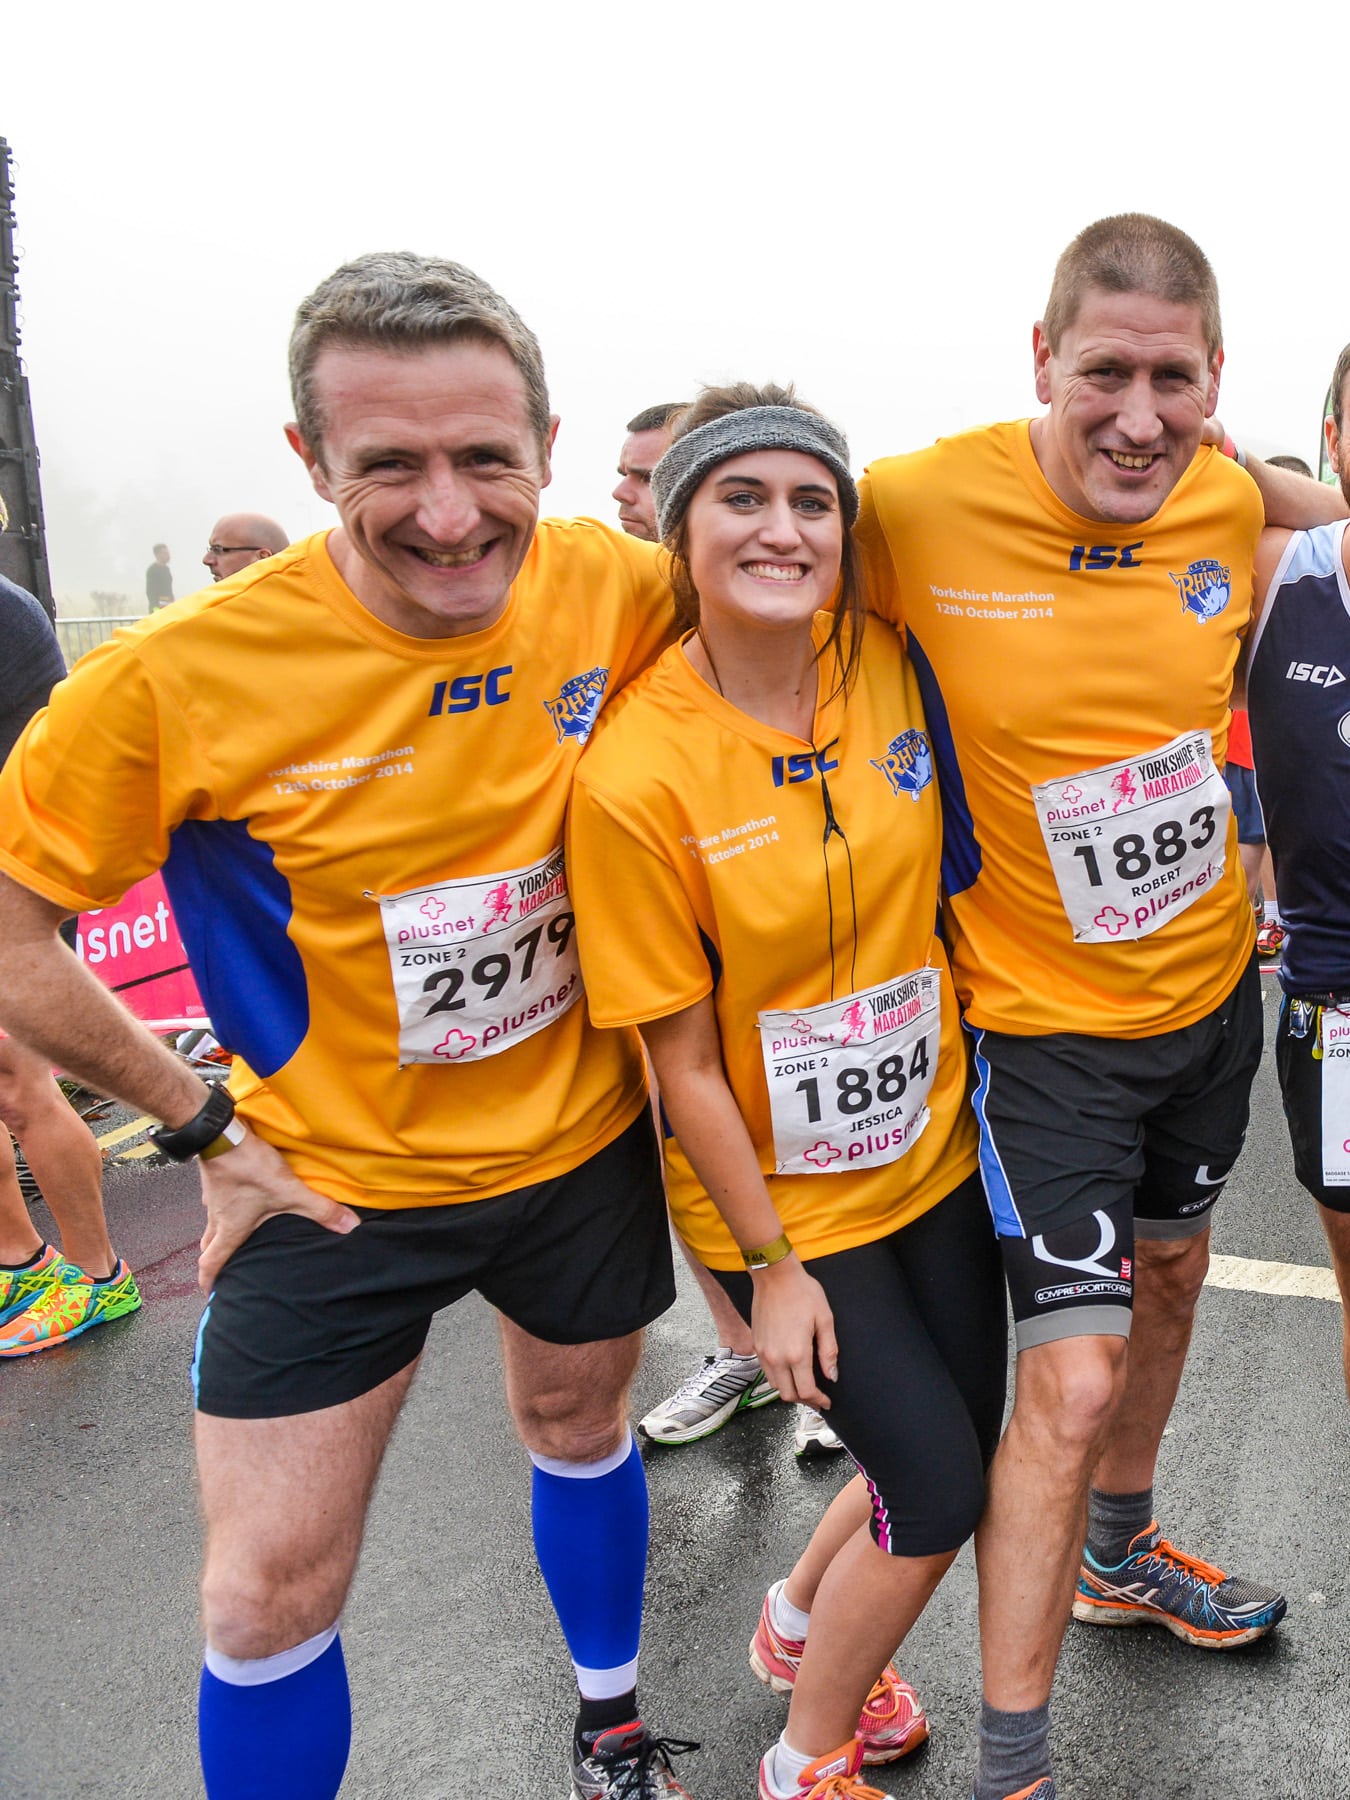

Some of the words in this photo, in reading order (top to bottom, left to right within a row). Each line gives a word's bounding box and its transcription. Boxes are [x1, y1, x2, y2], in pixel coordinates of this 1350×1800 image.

[1069, 541, 1145, 571] ISC
[929, 584, 989, 602] Yorkshire
[991, 591, 1055, 602] Marathon
[935, 603, 963, 616] 12th
[966, 606, 1019, 619] October
[1021, 607, 1054, 619] 2014
[428, 665, 513, 717] ISC
[341, 745, 415, 769] Marathon
[771, 736, 840, 788] ISC
[1138, 744, 1195, 782] YORKSHIRE
[273, 780, 309, 795] 12th
[310, 773, 371, 791] October
[375, 762, 414, 779] 2014
[1143, 762, 1203, 801] MARATHON
[1046, 798, 1106, 823] plusnet
[721, 815, 777, 841] Marathon
[747, 830, 780, 850] 2014
[1051, 829, 1090, 843] ZONE
[1094, 826, 1103, 836] 2
[1073, 805, 1216, 887] 1883
[519, 873, 565, 917] MARATH
[1131, 866, 1182, 897] ROBERT
[1134, 862, 1214, 929] plusnet
[397, 916, 475, 944] plusnet
[400, 951, 451, 967] ZONE
[457, 948, 466, 959] 2
[423, 911, 575, 1018] 2979
[482, 973, 577, 1048] plusnet
[868, 978, 920, 1016] YORKSHIRE
[873, 995, 922, 1036] MARATHON
[772, 1033, 835, 1054] plusnet
[774, 1060, 816, 1077] ZONE
[821, 1057, 829, 1067] 2
[795, 1036, 930, 1124] 1884
[850, 1106, 903, 1133] JESSICA
